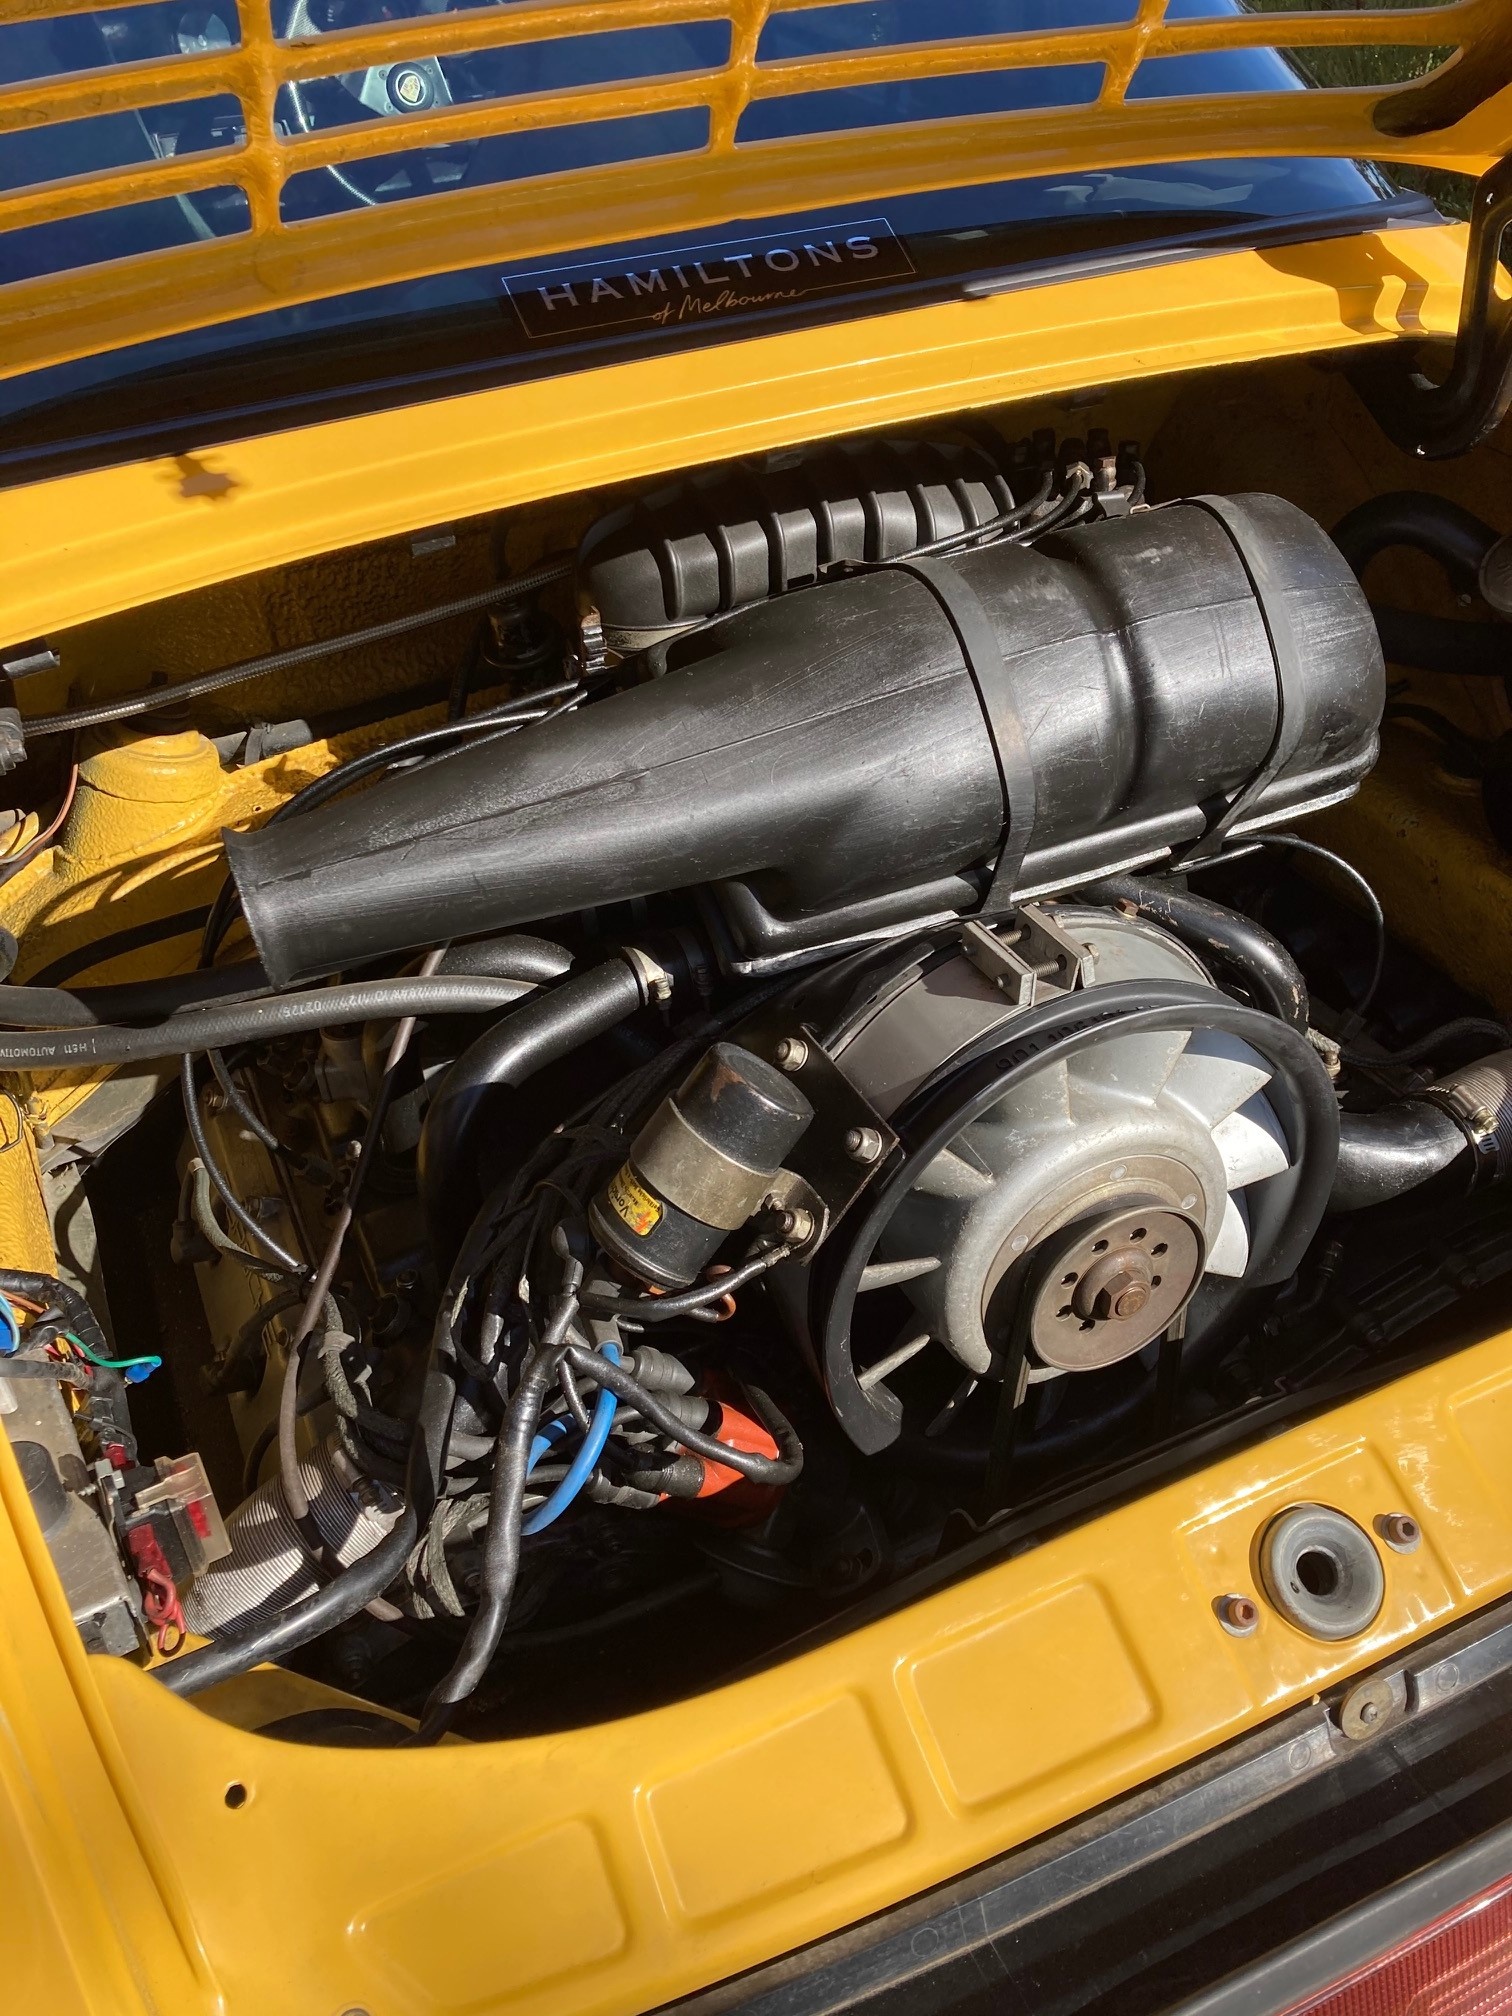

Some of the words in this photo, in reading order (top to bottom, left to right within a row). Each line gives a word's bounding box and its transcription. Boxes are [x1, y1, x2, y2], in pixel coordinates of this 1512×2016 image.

[537, 236, 879, 311] HAMILTONS
[651, 301, 676, 325] of
[678, 289, 803, 320] Melbourne
